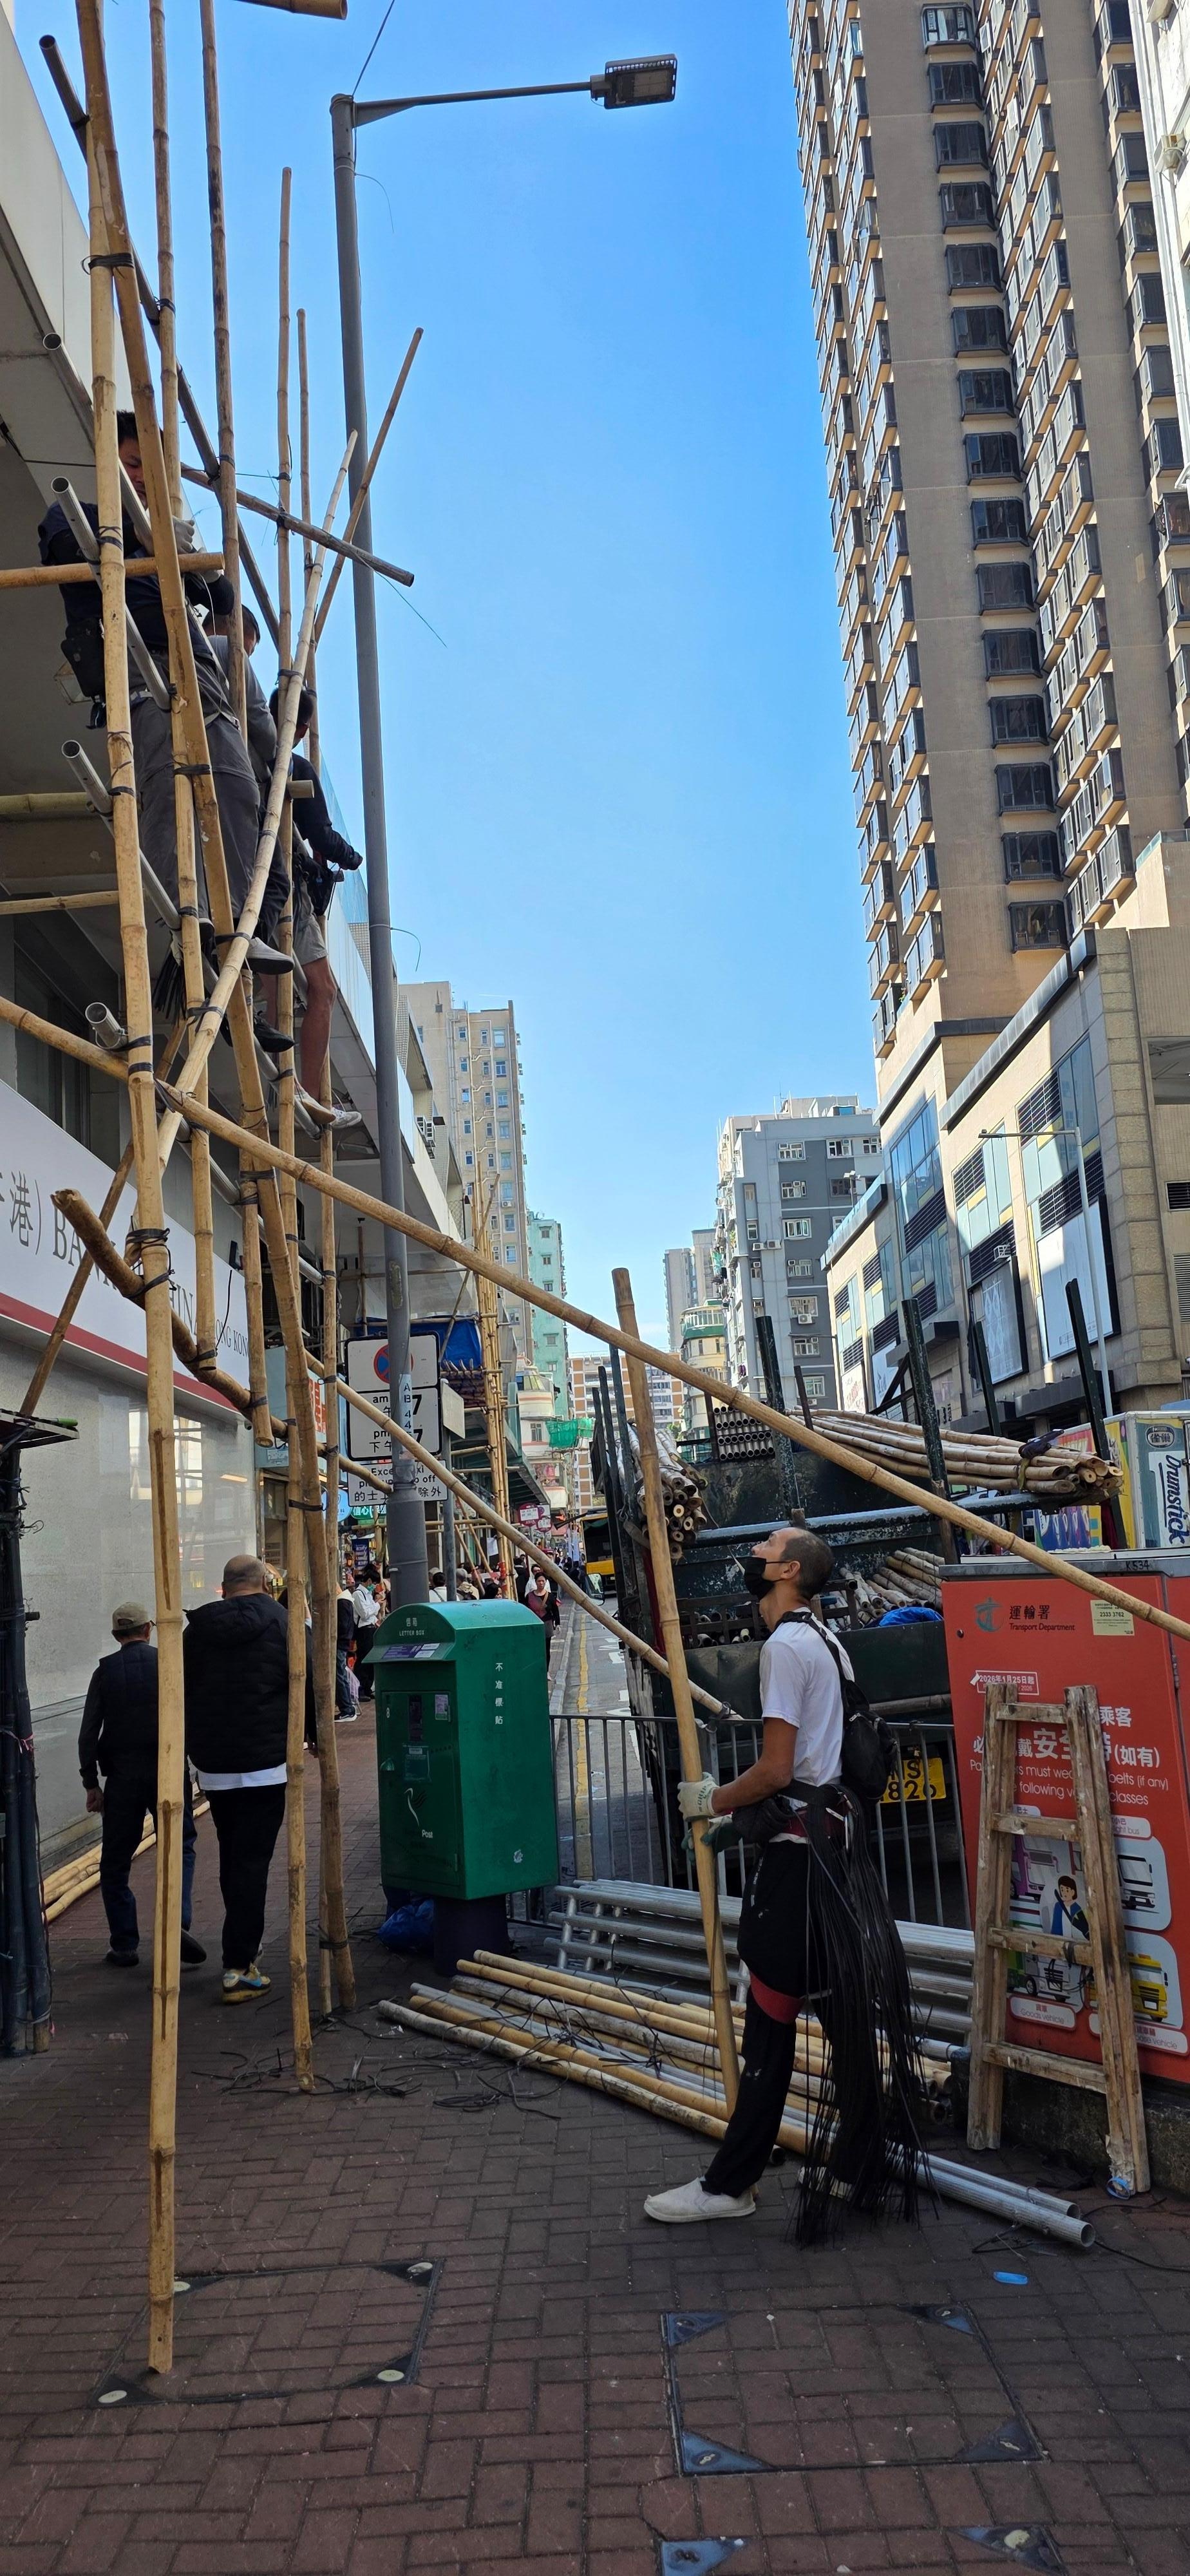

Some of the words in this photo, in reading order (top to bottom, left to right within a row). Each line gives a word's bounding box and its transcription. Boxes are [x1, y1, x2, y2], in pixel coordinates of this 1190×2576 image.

[422, 1474, 436, 1484] off
[1166, 1454, 1189, 1545] Drumstick
[1126, 1560, 1150, 1571] K534
[1009, 1605, 1050, 1620] 運輸署
[1009, 1623, 1037, 1633] Transport
[1038, 1623, 1075, 1633] Department
[1026, 1765, 1052, 1778] must
[1137, 1775, 1146, 1788] (if
[1148, 1777, 1169, 1791] any)
[1019, 1781, 1064, 1800] following
[1110, 1790, 1149, 1806] classes
[422, 1829, 433, 1839] Post
